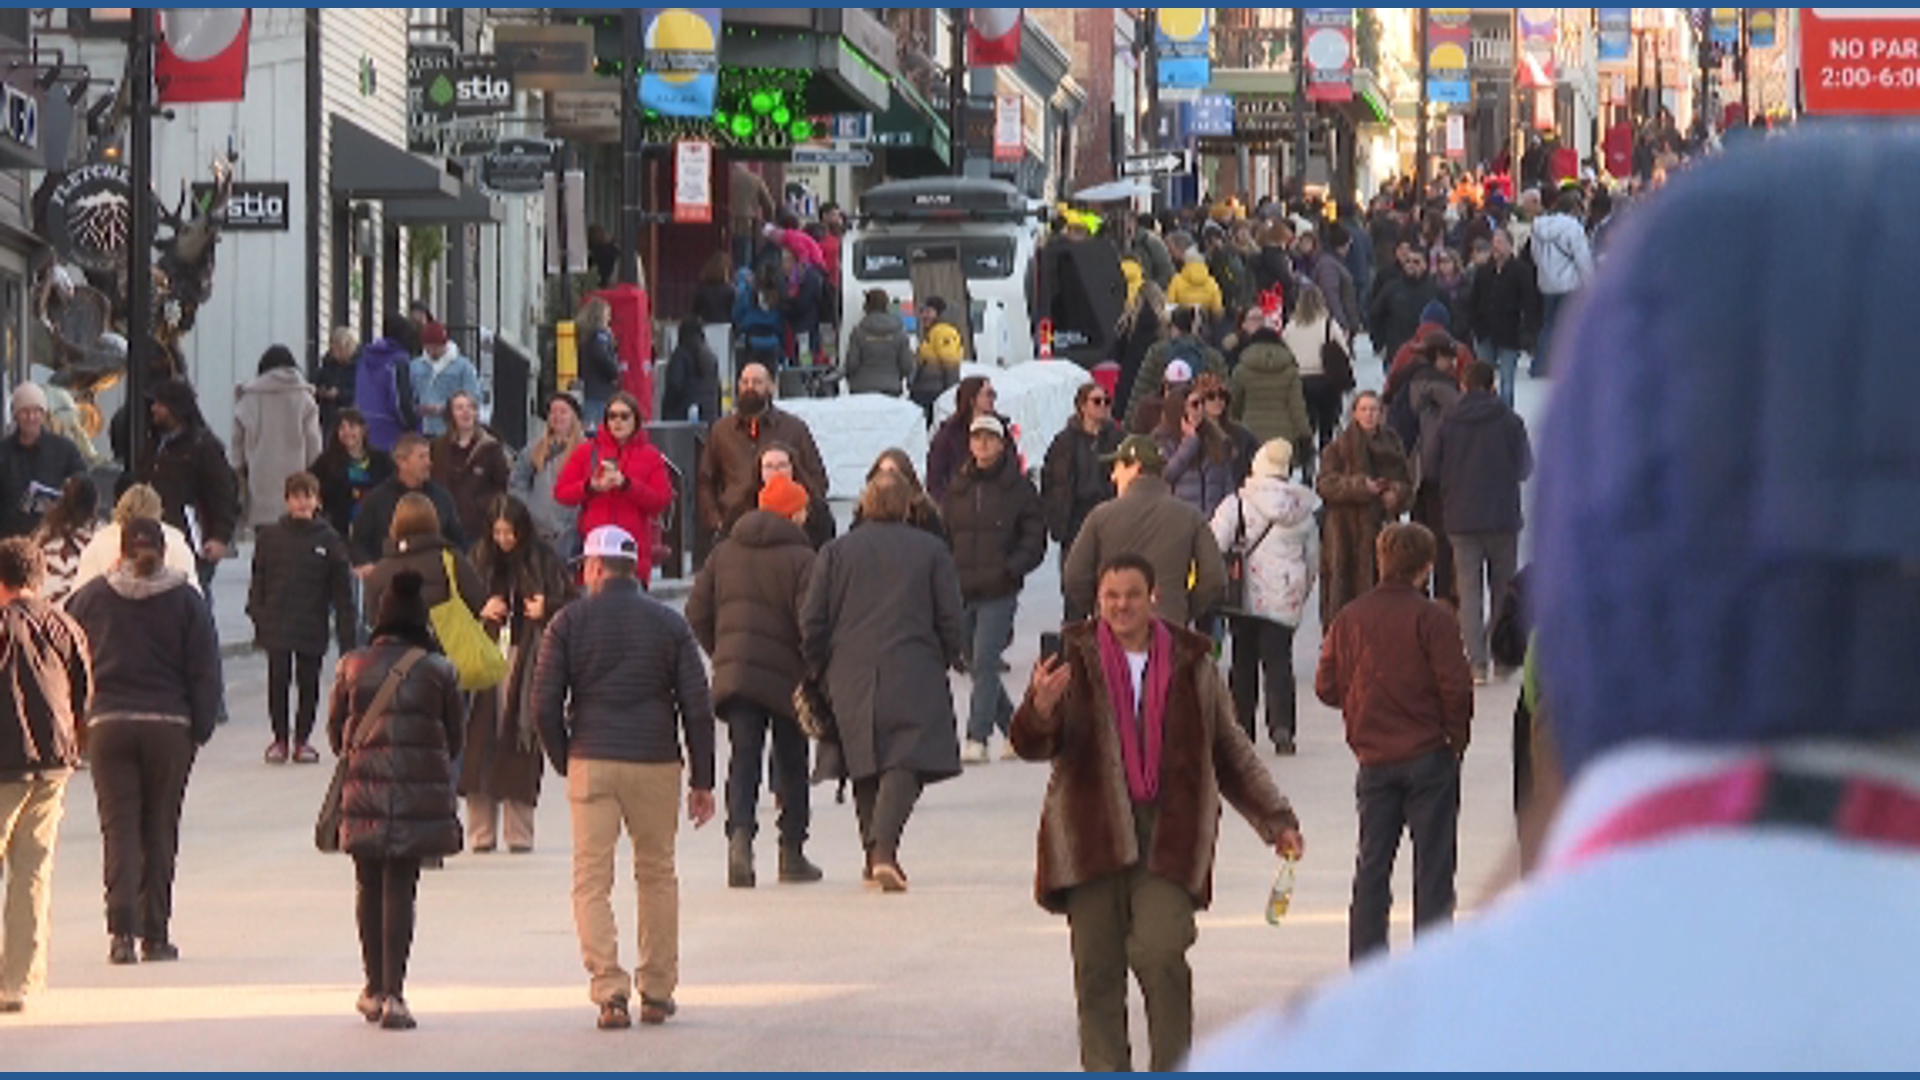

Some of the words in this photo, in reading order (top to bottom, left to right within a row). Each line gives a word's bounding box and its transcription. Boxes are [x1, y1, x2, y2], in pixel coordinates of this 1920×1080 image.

[1830, 37, 1864, 59] NO
[1871, 37, 1918, 59] PAR
[456, 75, 511, 101] stio
[228, 192, 283, 218] stio
